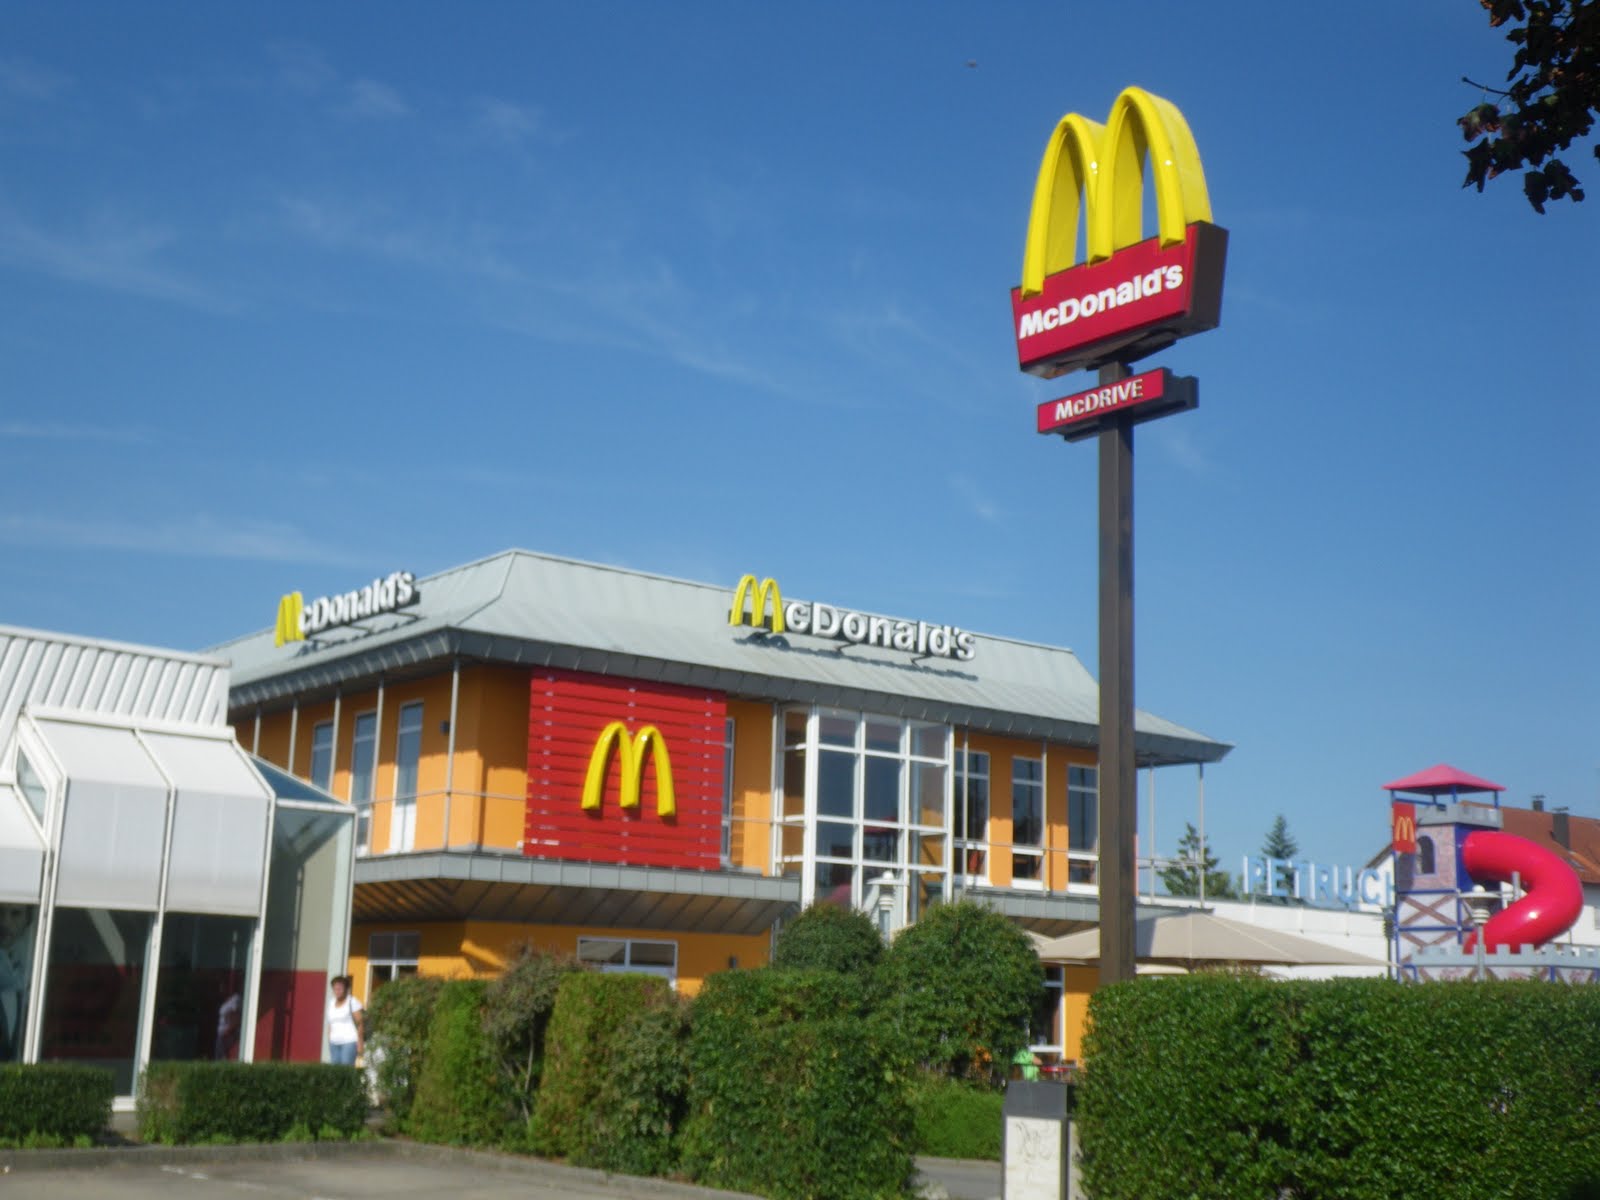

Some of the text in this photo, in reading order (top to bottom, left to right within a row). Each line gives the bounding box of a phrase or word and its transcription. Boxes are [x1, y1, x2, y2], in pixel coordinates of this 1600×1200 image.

[1019, 264, 1184, 340] McDonald's
[1054, 378, 1143, 421] McDRIVE
[274, 571, 414, 648] McDonald's
[729, 573, 977, 661] McDonald's
[580, 720, 677, 817] M
